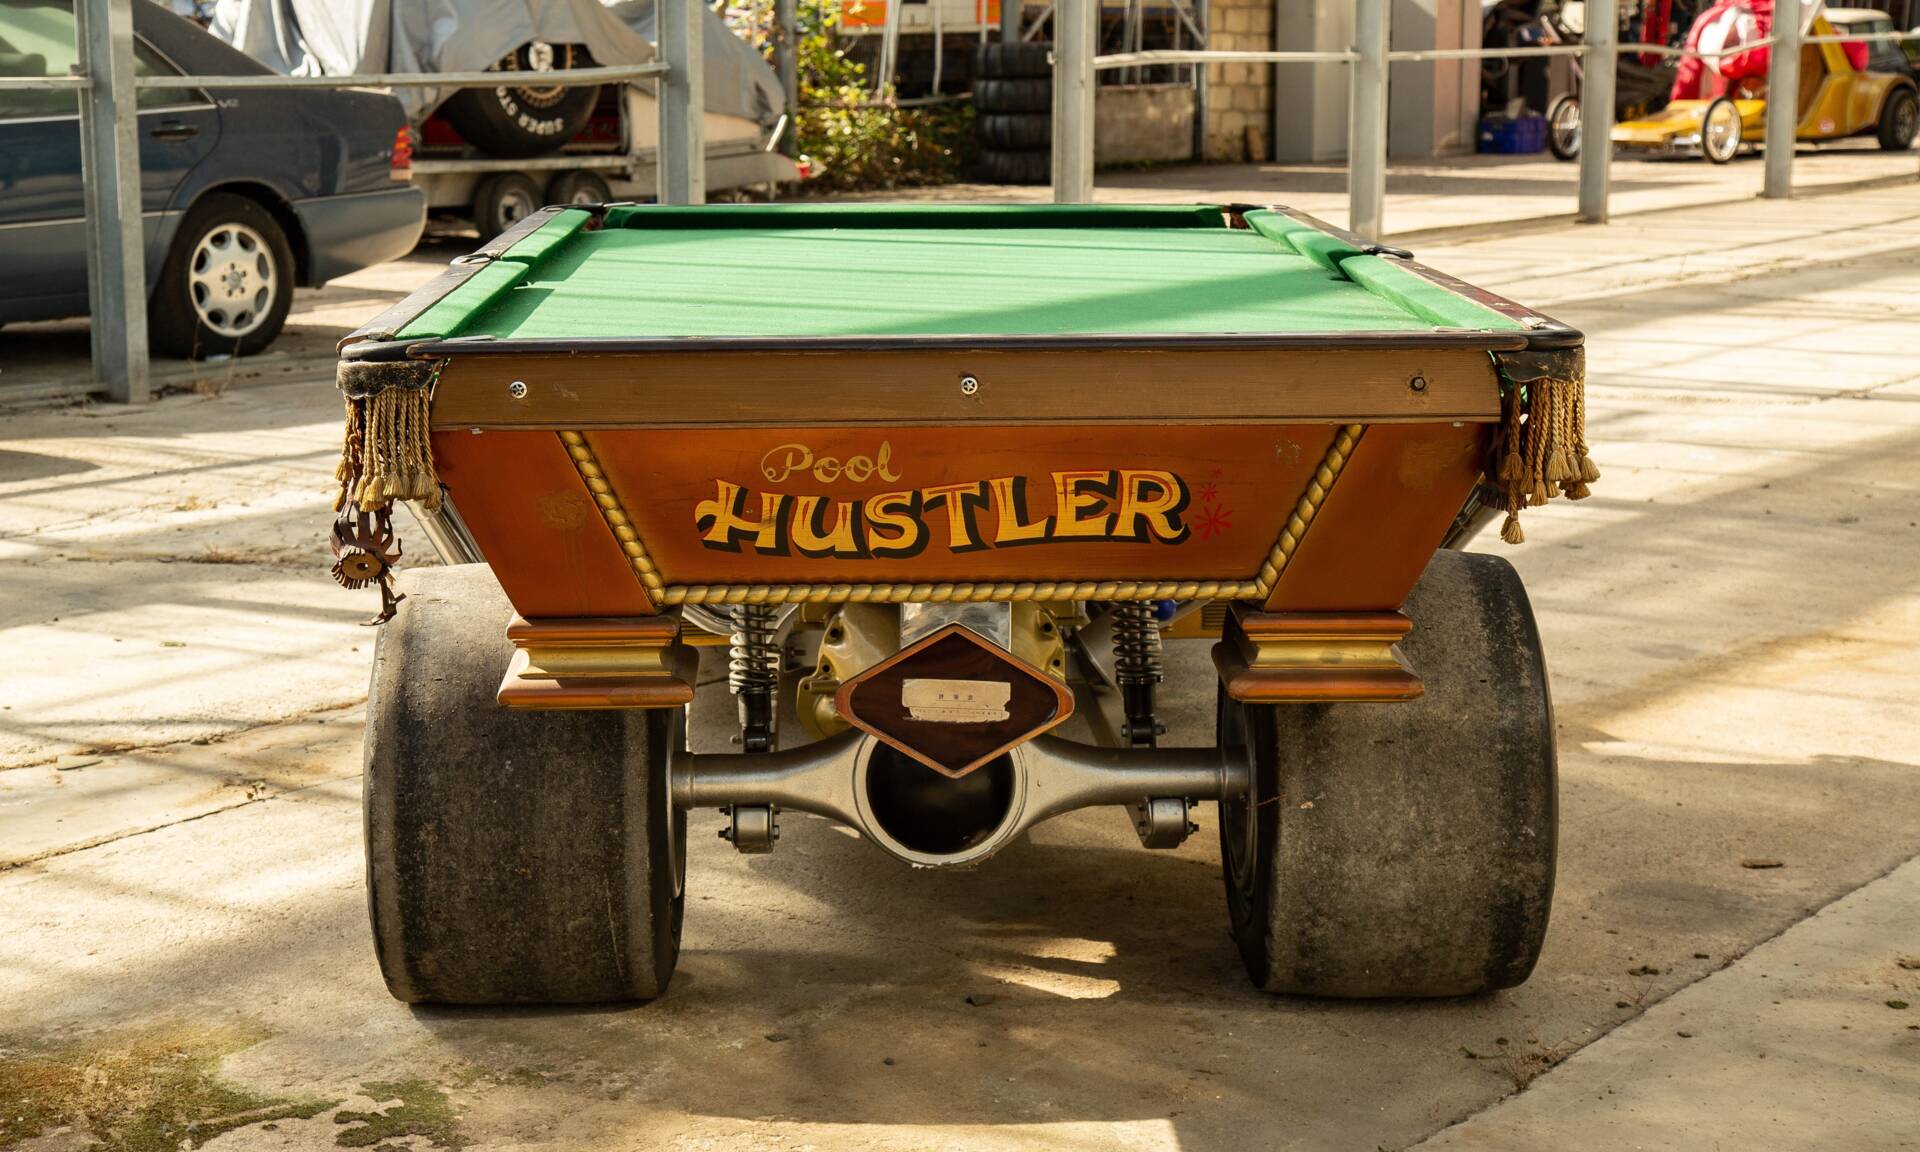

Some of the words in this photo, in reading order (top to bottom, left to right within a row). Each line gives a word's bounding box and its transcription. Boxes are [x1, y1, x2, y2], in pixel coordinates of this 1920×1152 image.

[519, 113, 563, 135] SUPER
[761, 440, 902, 483] Pool
[694, 469, 1191, 560] HUSTLER
